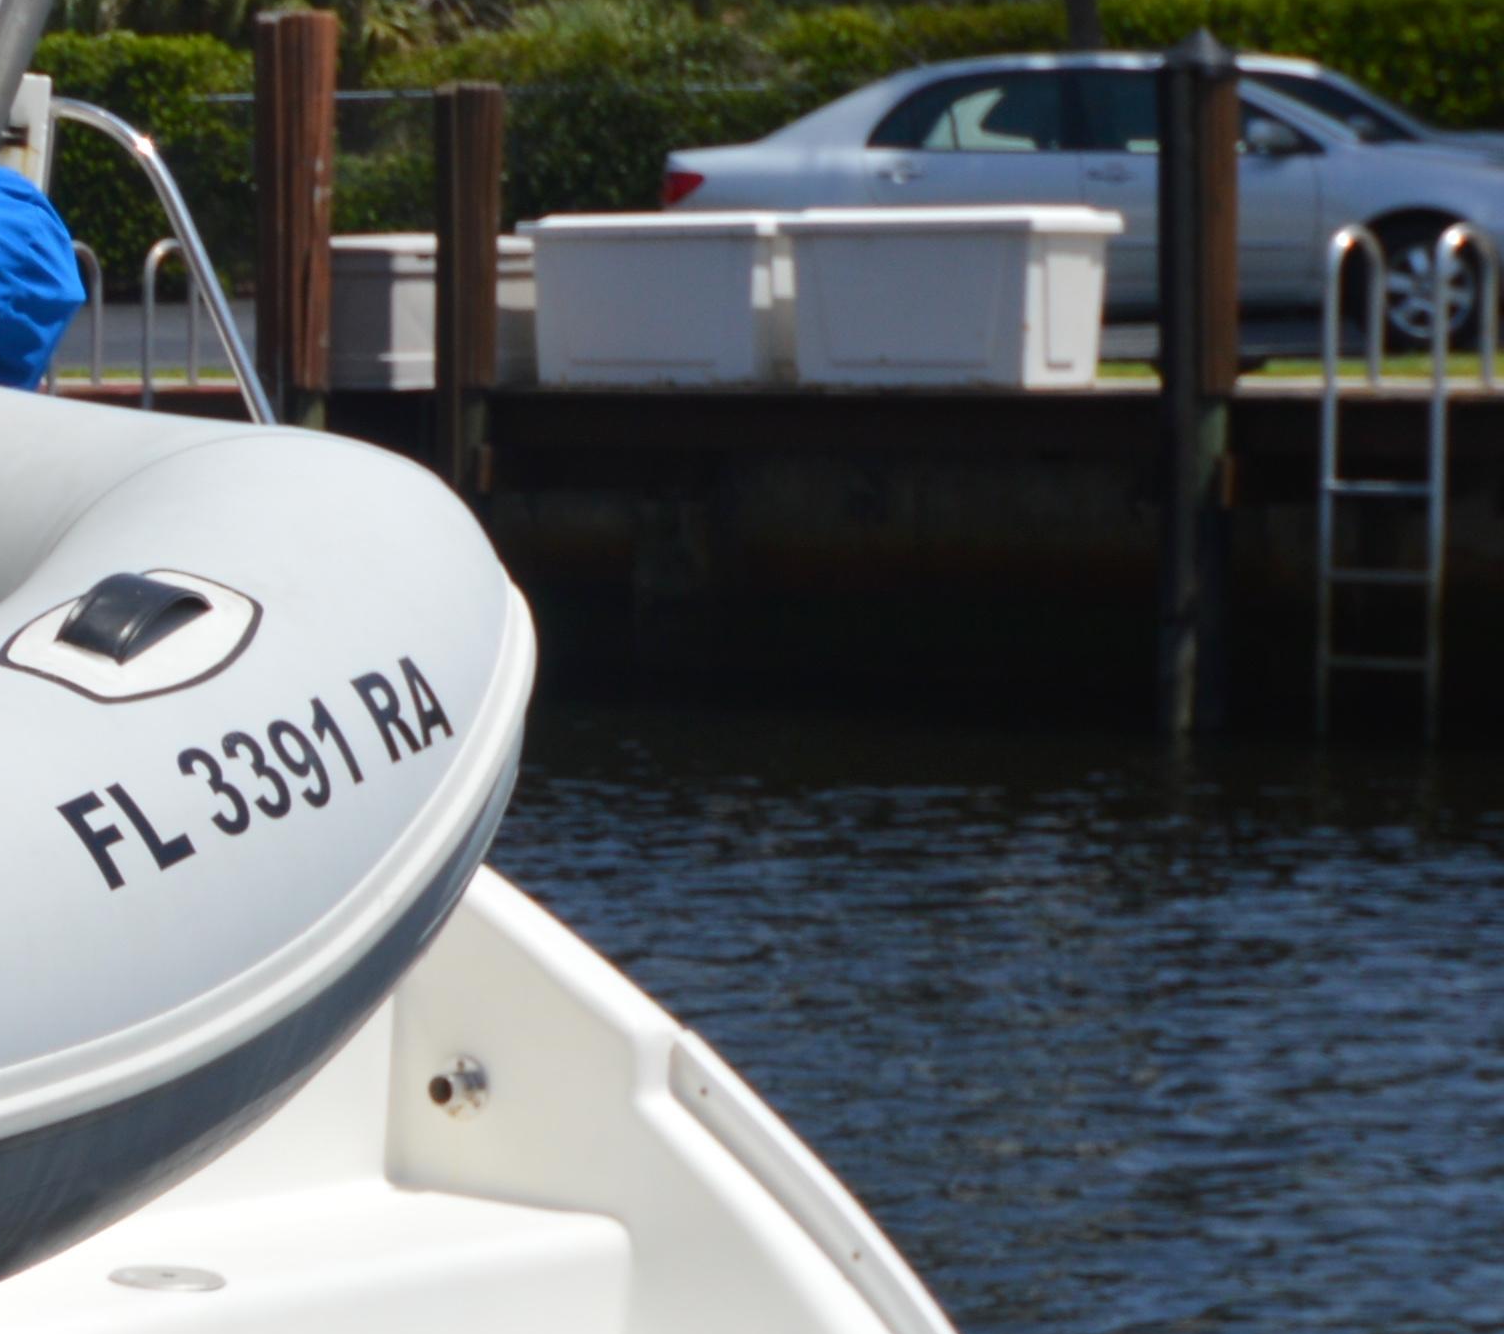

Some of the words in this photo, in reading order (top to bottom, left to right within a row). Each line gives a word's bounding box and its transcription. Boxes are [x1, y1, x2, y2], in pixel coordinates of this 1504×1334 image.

[55, 782, 196, 891] FL
[177, 697, 365, 836] 3391
[350, 656, 454, 763] RA
